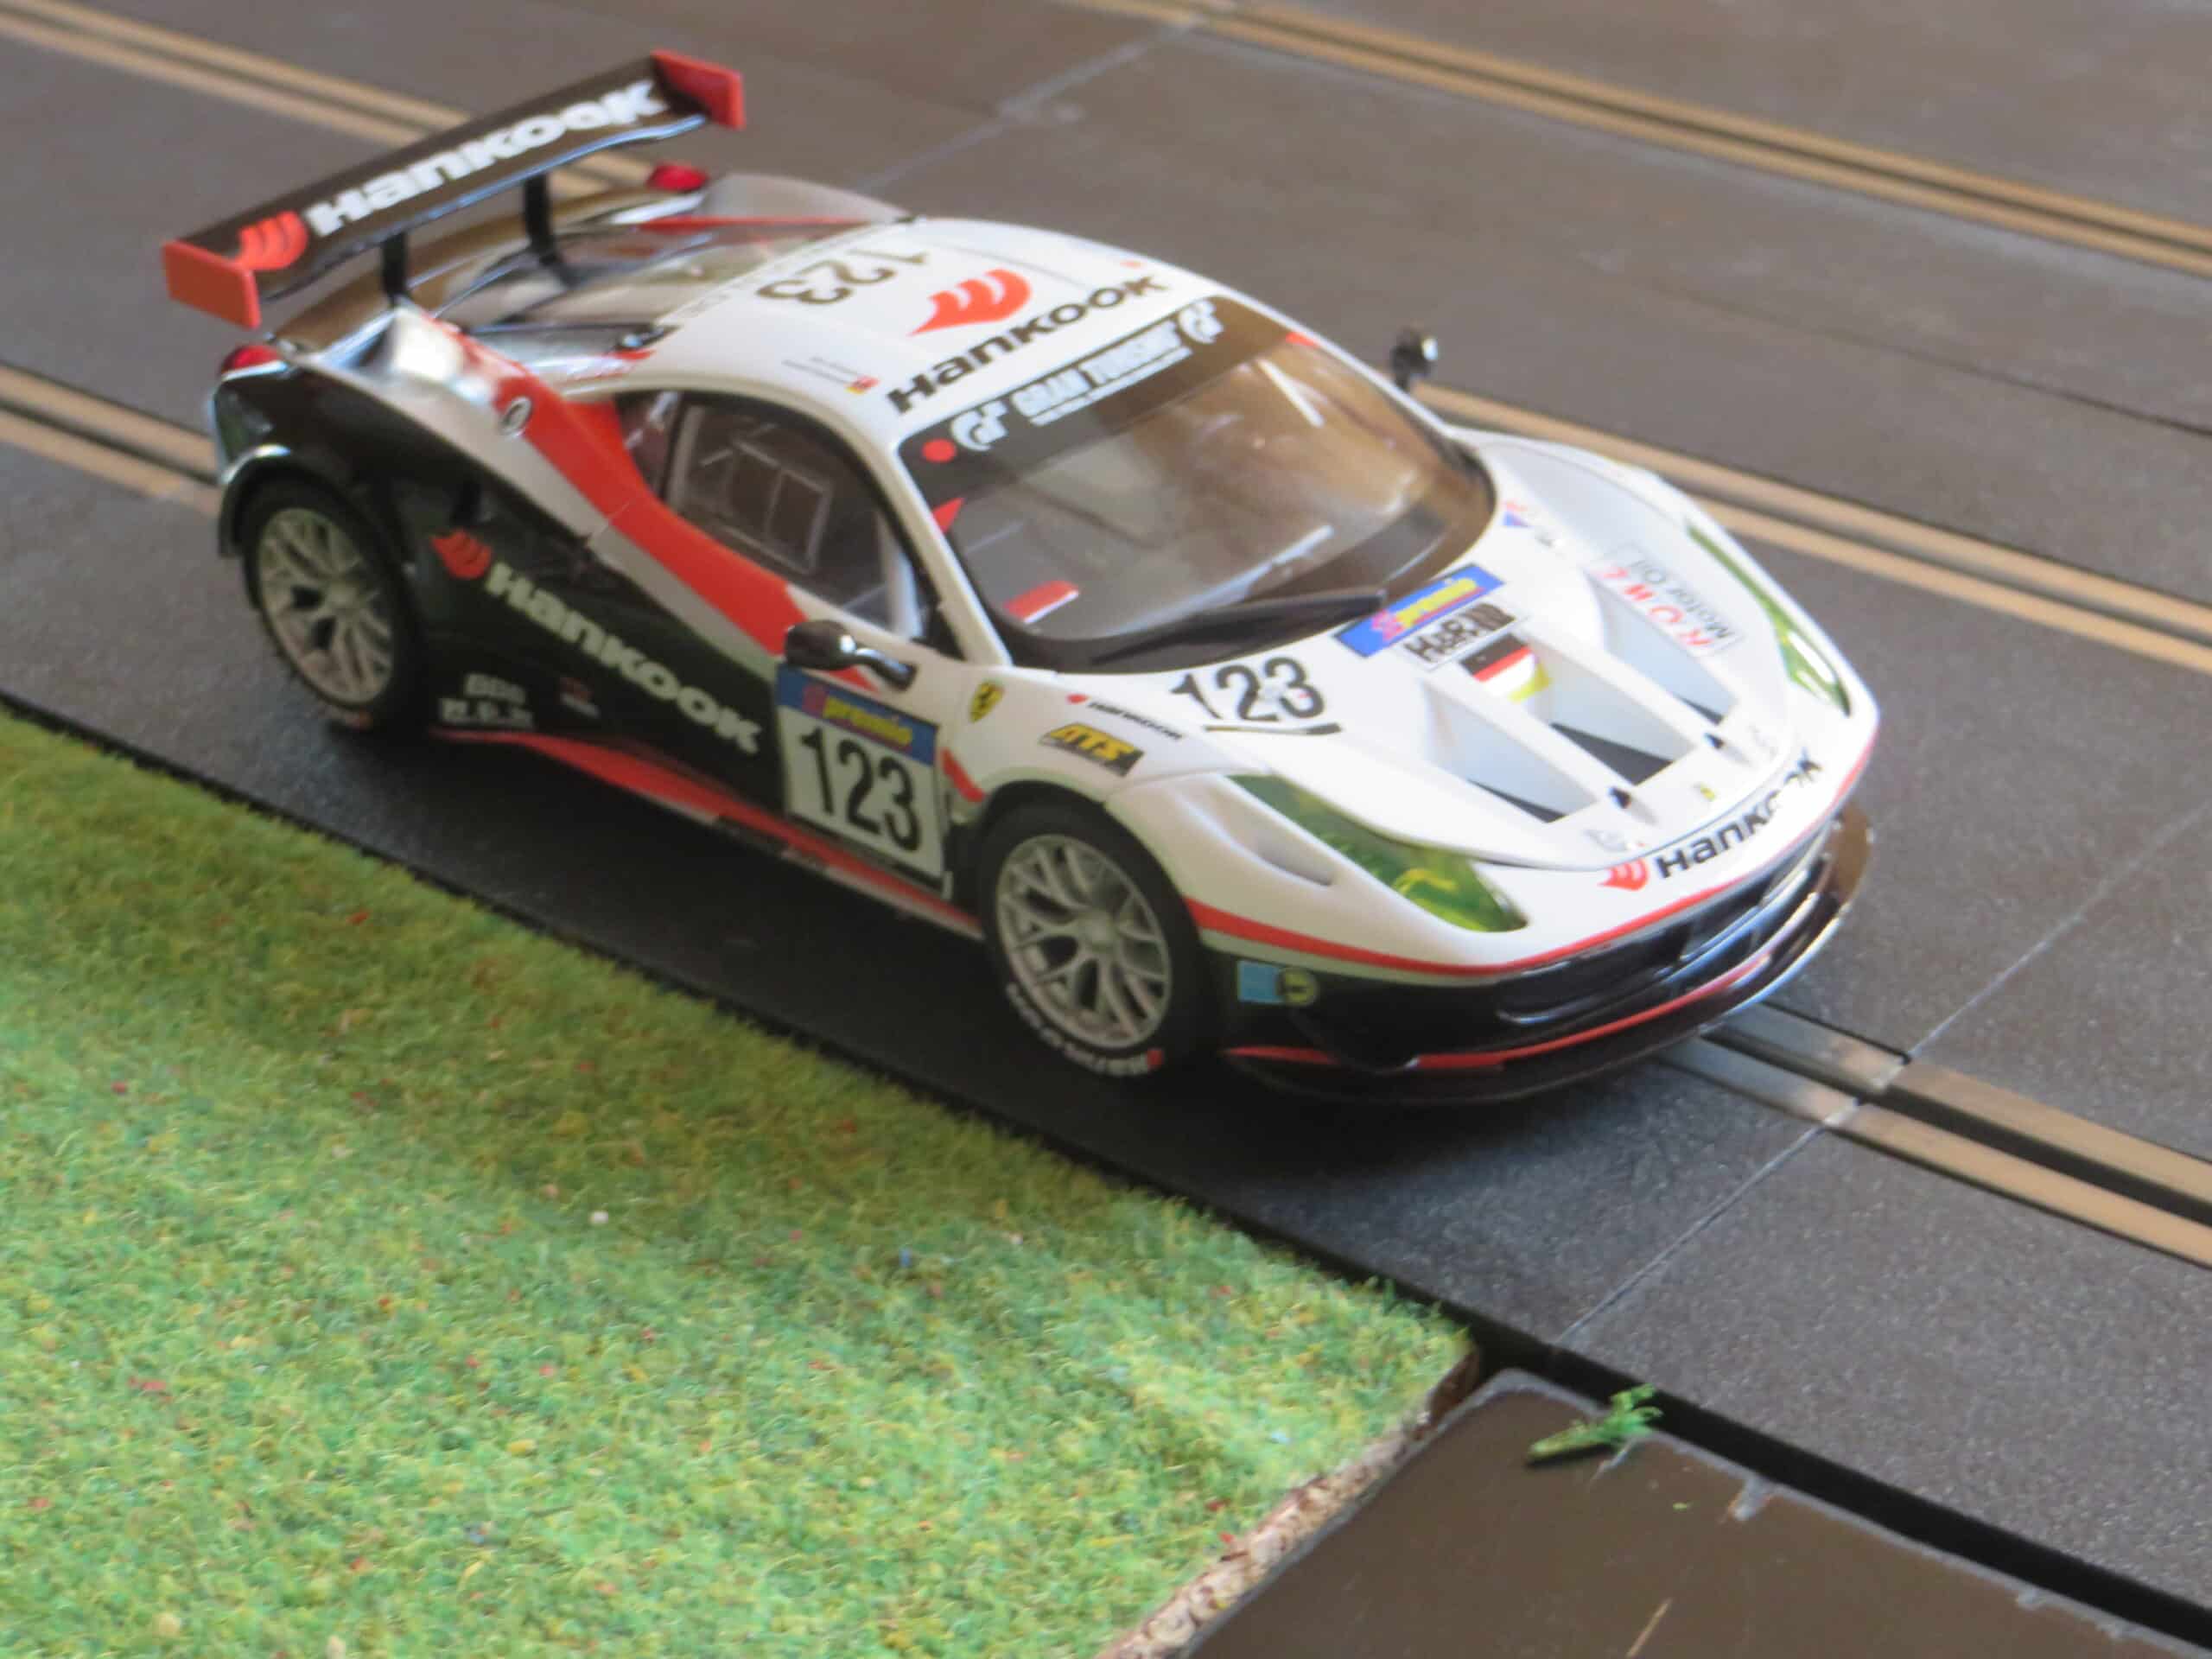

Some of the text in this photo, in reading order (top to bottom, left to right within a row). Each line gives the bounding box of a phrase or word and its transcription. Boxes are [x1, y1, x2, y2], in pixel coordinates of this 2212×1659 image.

[754, 247, 928, 305] 123
[1171, 656, 1325, 721] 123
[800, 727, 924, 855] 123
